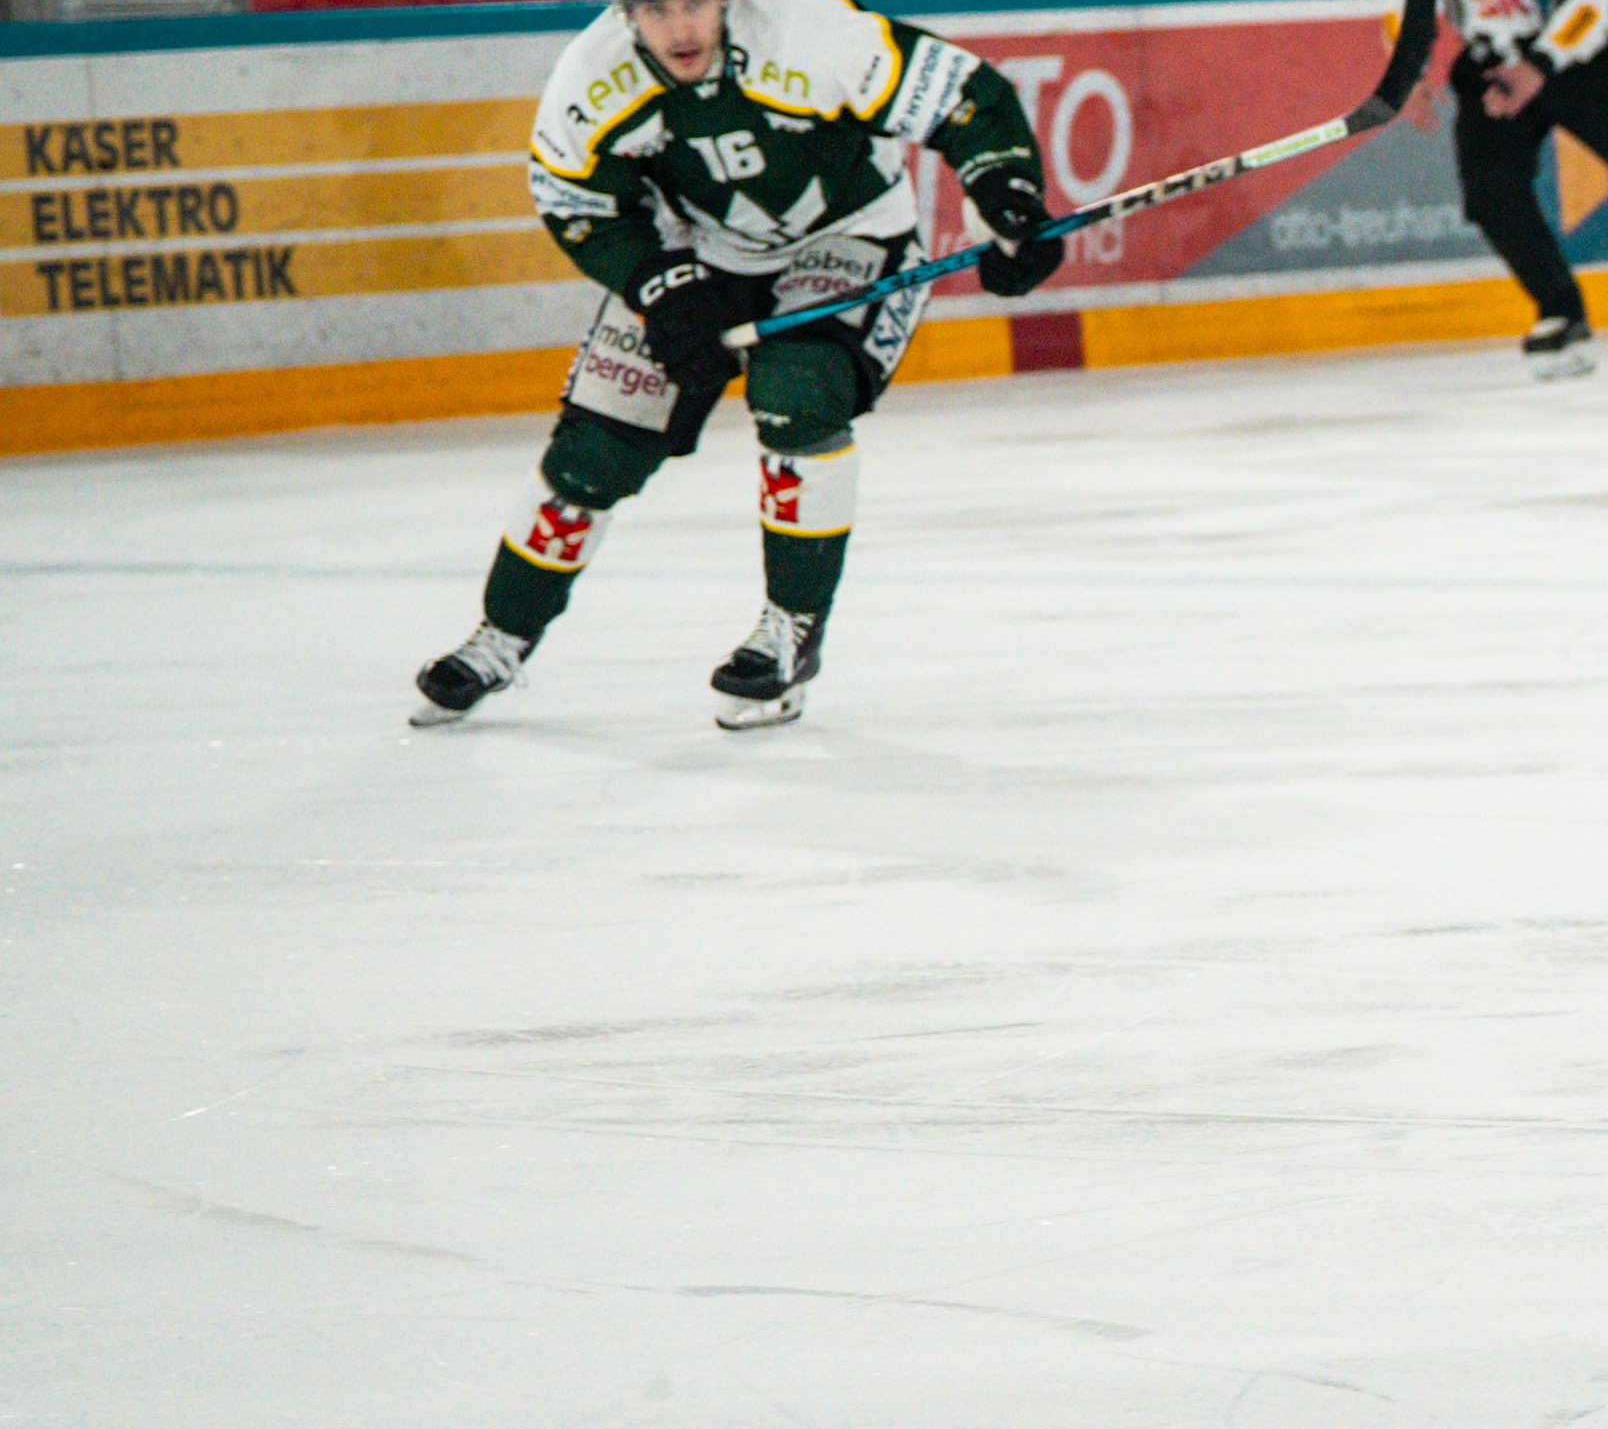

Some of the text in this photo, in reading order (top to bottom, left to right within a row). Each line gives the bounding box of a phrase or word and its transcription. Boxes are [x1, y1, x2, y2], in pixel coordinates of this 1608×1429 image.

[686, 128, 767, 184] 16
[32, 182, 242, 244] ELEKTRO
[36, 245, 297, 313] TELEMATIK
